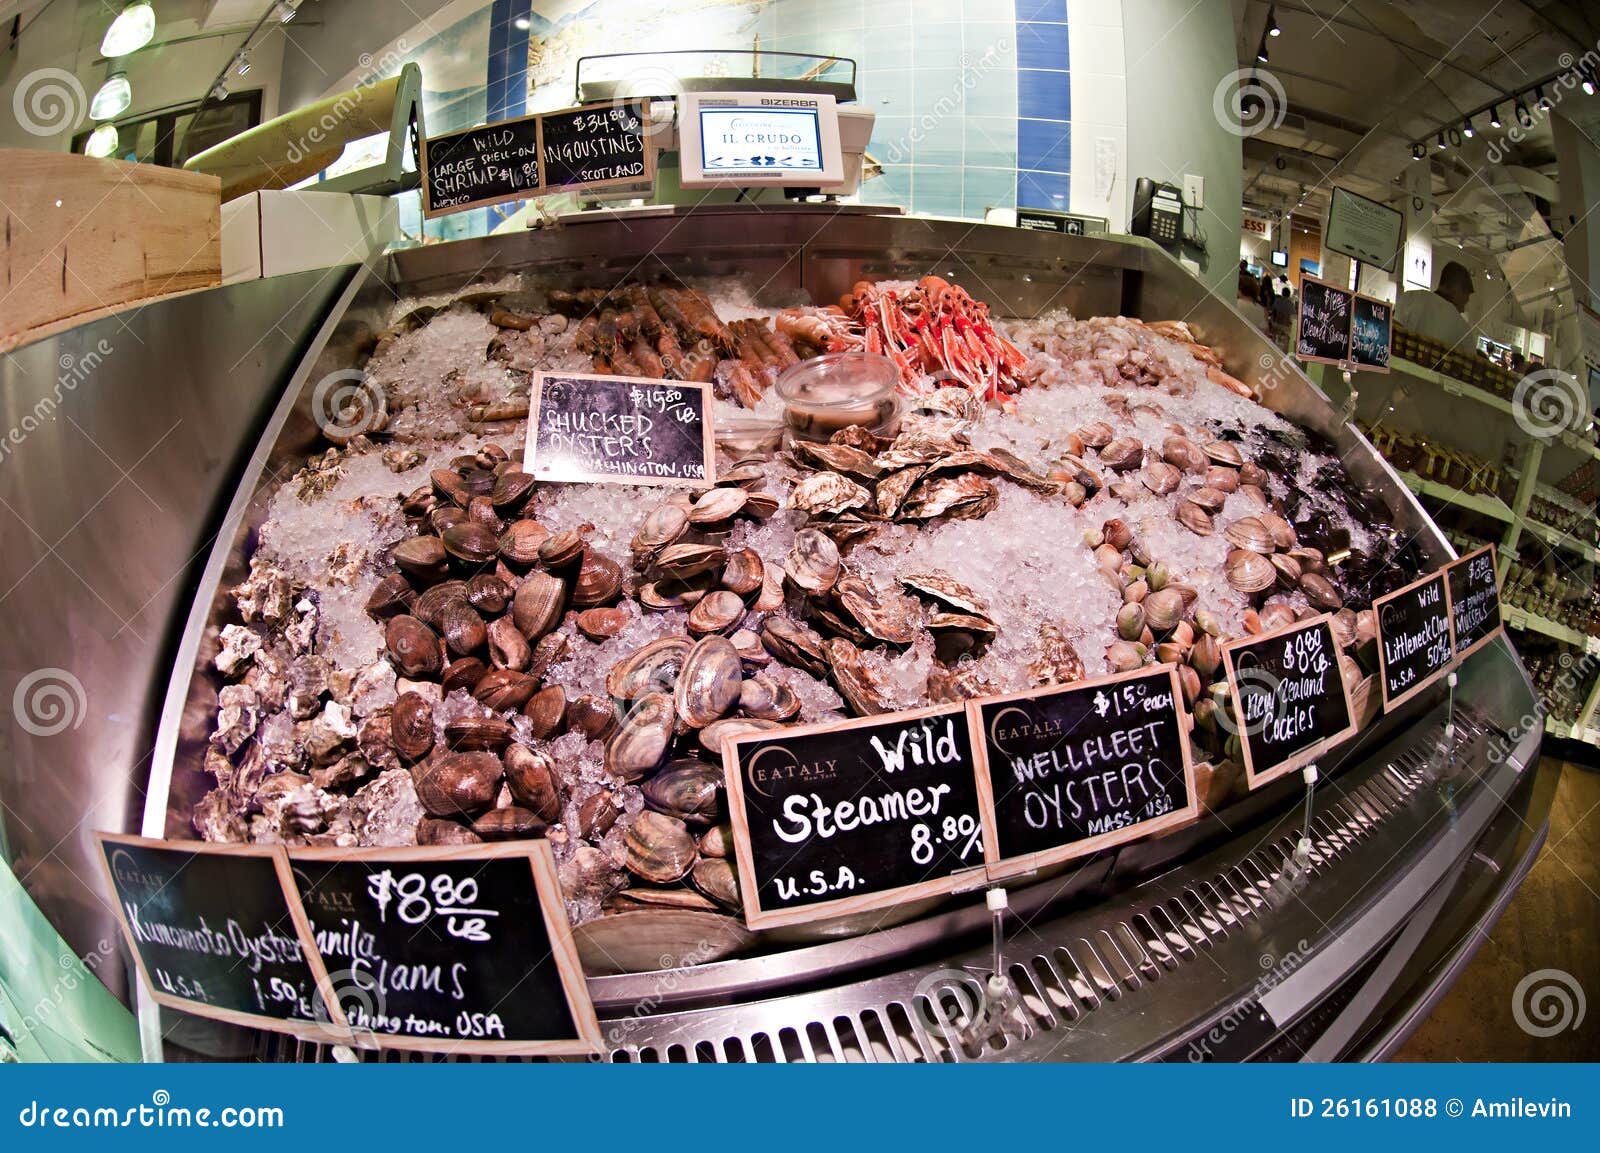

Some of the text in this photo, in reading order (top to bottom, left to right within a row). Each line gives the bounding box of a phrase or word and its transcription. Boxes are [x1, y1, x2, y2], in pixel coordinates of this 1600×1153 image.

[760, 98, 818, 107] BIZERBA
[722, 133, 802, 144] IL CRUDO
[434, 157, 476, 179] LARGE
[434, 166, 498, 197] SHRIMP
[581, 162, 644, 182] SCOTLAND
[546, 409, 653, 436] SHUCKED
[550, 431, 653, 460] OYSTERS
[1418, 583, 1440, 608] Wild
[998, 719, 1063, 741] EATALY
[870, 718, 961, 774] Wild
[1011, 721, 1165, 784] WELLFLEET
[756, 759, 838, 783] EATALY
[1024, 758, 1166, 829] OYSTERS
[773, 783, 951, 843] Steamer
[310, 918, 381, 961] anila
[351, 957, 467, 1001] Clams
[456, 1009, 506, 1040] USA
